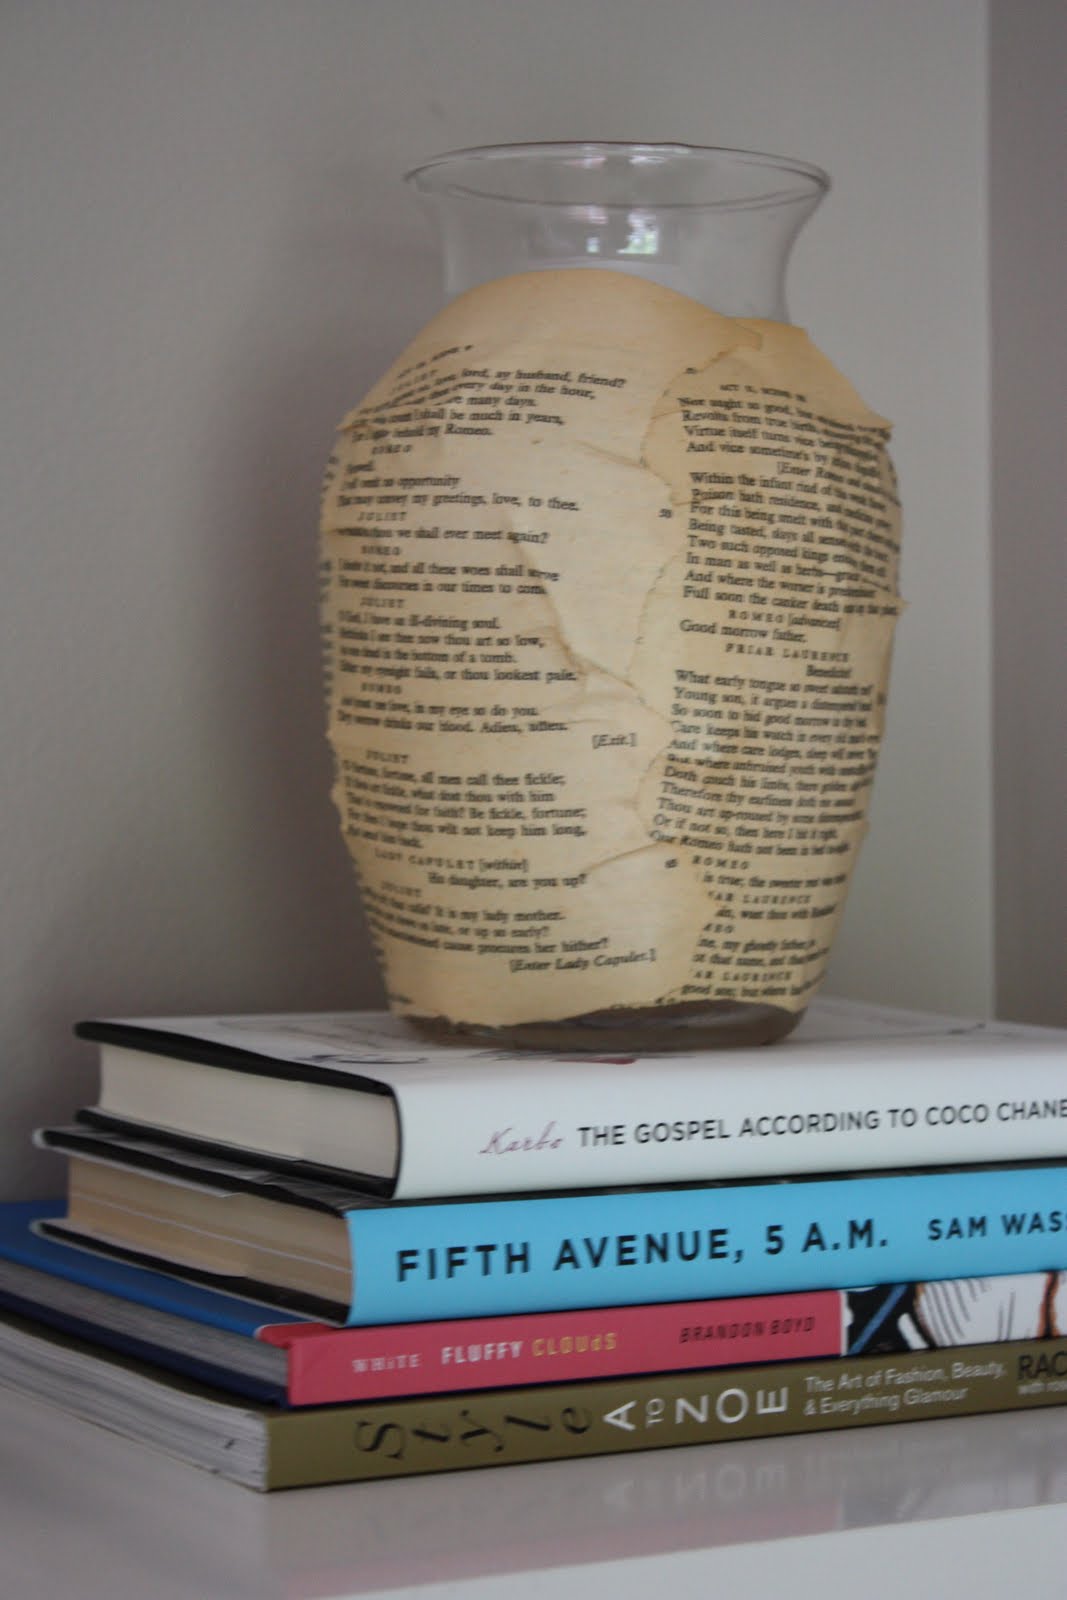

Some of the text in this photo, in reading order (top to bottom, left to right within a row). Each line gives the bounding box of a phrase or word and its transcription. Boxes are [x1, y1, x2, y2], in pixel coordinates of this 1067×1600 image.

[489, 382, 512, 394] day
[534, 385, 555, 394] the
[466, 397, 500, 409] many
[450, 409, 465, 420] be
[469, 411, 503, 421] much
[686, 441, 716, 452] And
[528, 496, 543, 507] to
[688, 517, 725, 536] Being
[685, 552, 700, 565] In
[704, 556, 732, 569] man
[494, 564, 525, 577] shall
[684, 568, 715, 583] And
[498, 583, 514, 595] to
[682, 585, 711, 600] Full
[714, 591, 744, 604] soon
[748, 592, 768, 606] the
[728, 608, 784, 625] ROMEO
[680, 618, 717, 635] Good
[725, 643, 849, 664] FRIAR LAURENCE
[674, 669, 711, 685] What
[673, 686, 719, 705] Young
[490, 704, 508, 716] do
[671, 702, 689, 716] So
[692, 707, 725, 720] soon
[465, 772, 488, 785] call
[656, 796, 693, 815] Thou
[653, 812, 674, 827] Or
[691, 853, 750, 870] ROMEO
[576, 1123, 627, 1148] THE
[633, 1118, 732, 1145] GOSPEL
[738, 1109, 881, 1138] ACCORDING
[888, 1107, 918, 1129] TO
[925, 1102, 990, 1127] COCO
[928, 1208, 1067, 1241] SAM WAS
[396, 1218, 889, 1282] FIFTH AVENUE, 5 A.M.
[440, 1340, 525, 1366] FLUFFY
[805, 1375, 835, 1393] The
[838, 1372, 862, 1390] Art
[865, 1370, 883, 1388] of
[884, 1364, 948, 1386] Fashion,
[803, 1387, 970, 1416] & Everything Glamour
[603, 1400, 638, 1431] A
